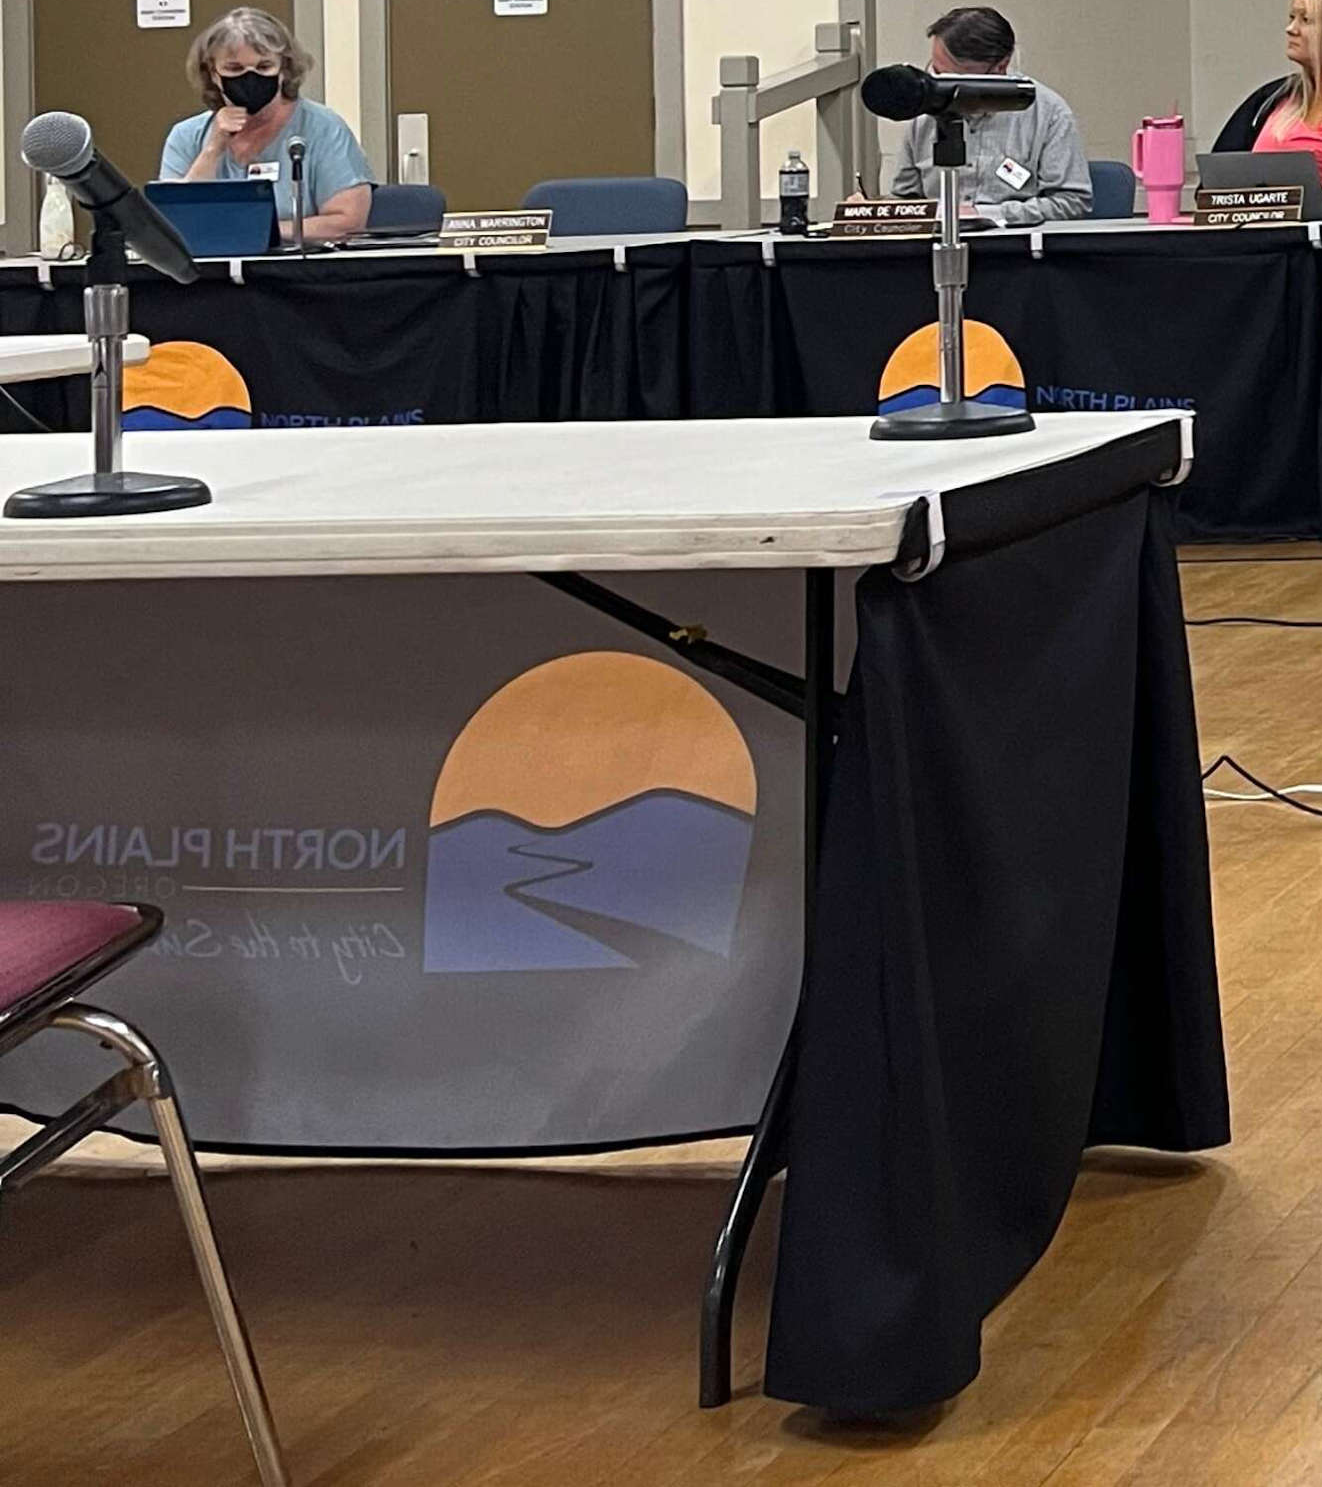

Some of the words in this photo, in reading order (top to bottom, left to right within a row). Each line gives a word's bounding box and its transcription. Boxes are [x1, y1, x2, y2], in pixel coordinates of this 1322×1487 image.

[1210, 193, 1245, 206] TRISTA
[1248, 191, 1289, 204] UGARTE
[843, 206, 873, 217] MARK
[876, 205, 891, 217] DE
[1207, 212, 1230, 224] CITY
[1231, 210, 1285, 222] COUNCILOR
[453, 237, 475, 247] CITY
[477, 234, 534, 246] COUNCILOR
